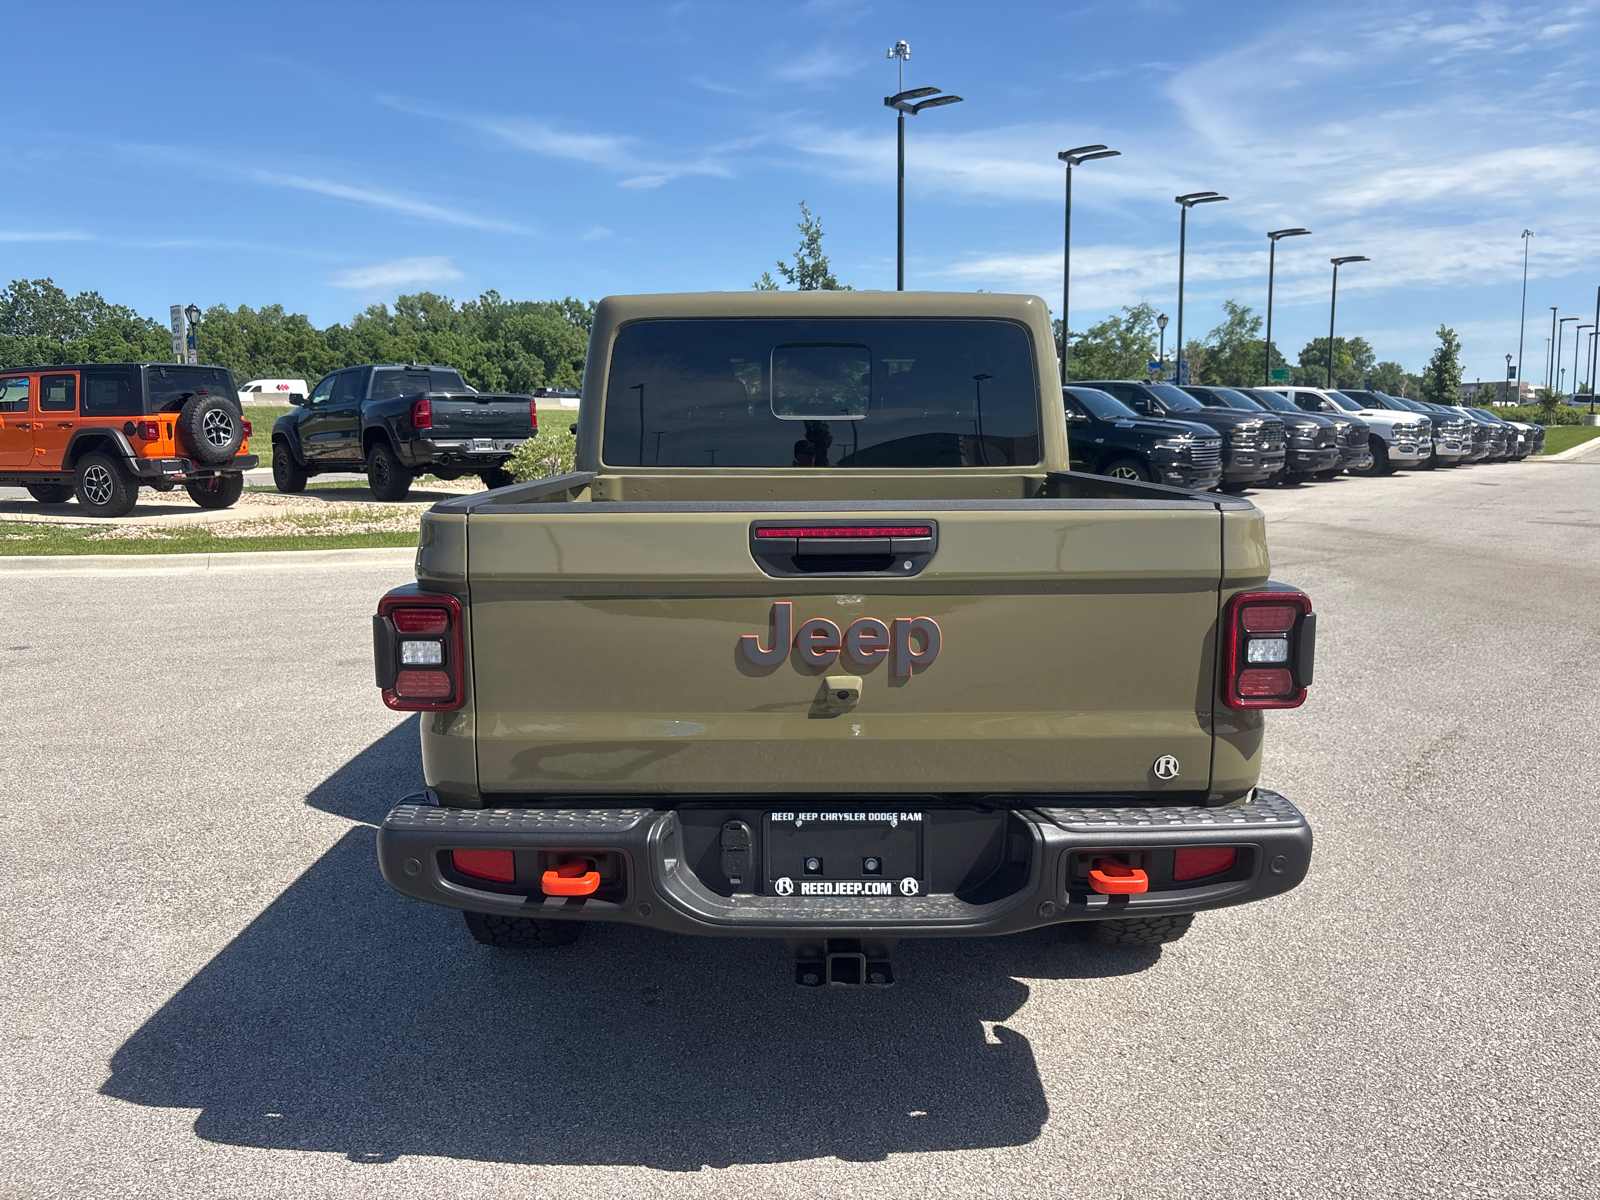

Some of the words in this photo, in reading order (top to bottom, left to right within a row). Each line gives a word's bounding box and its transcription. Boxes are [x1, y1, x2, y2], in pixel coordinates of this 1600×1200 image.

[742, 601, 943, 678] Jeep
[771, 812, 794, 821] REED
[797, 812, 818, 821] JEEP
[820, 812, 866, 821] CHRYSLER
[868, 812, 898, 821] DODGE
[900, 812, 922, 821] RAM
[801, 882, 892, 895] REEDJEEP.COM
